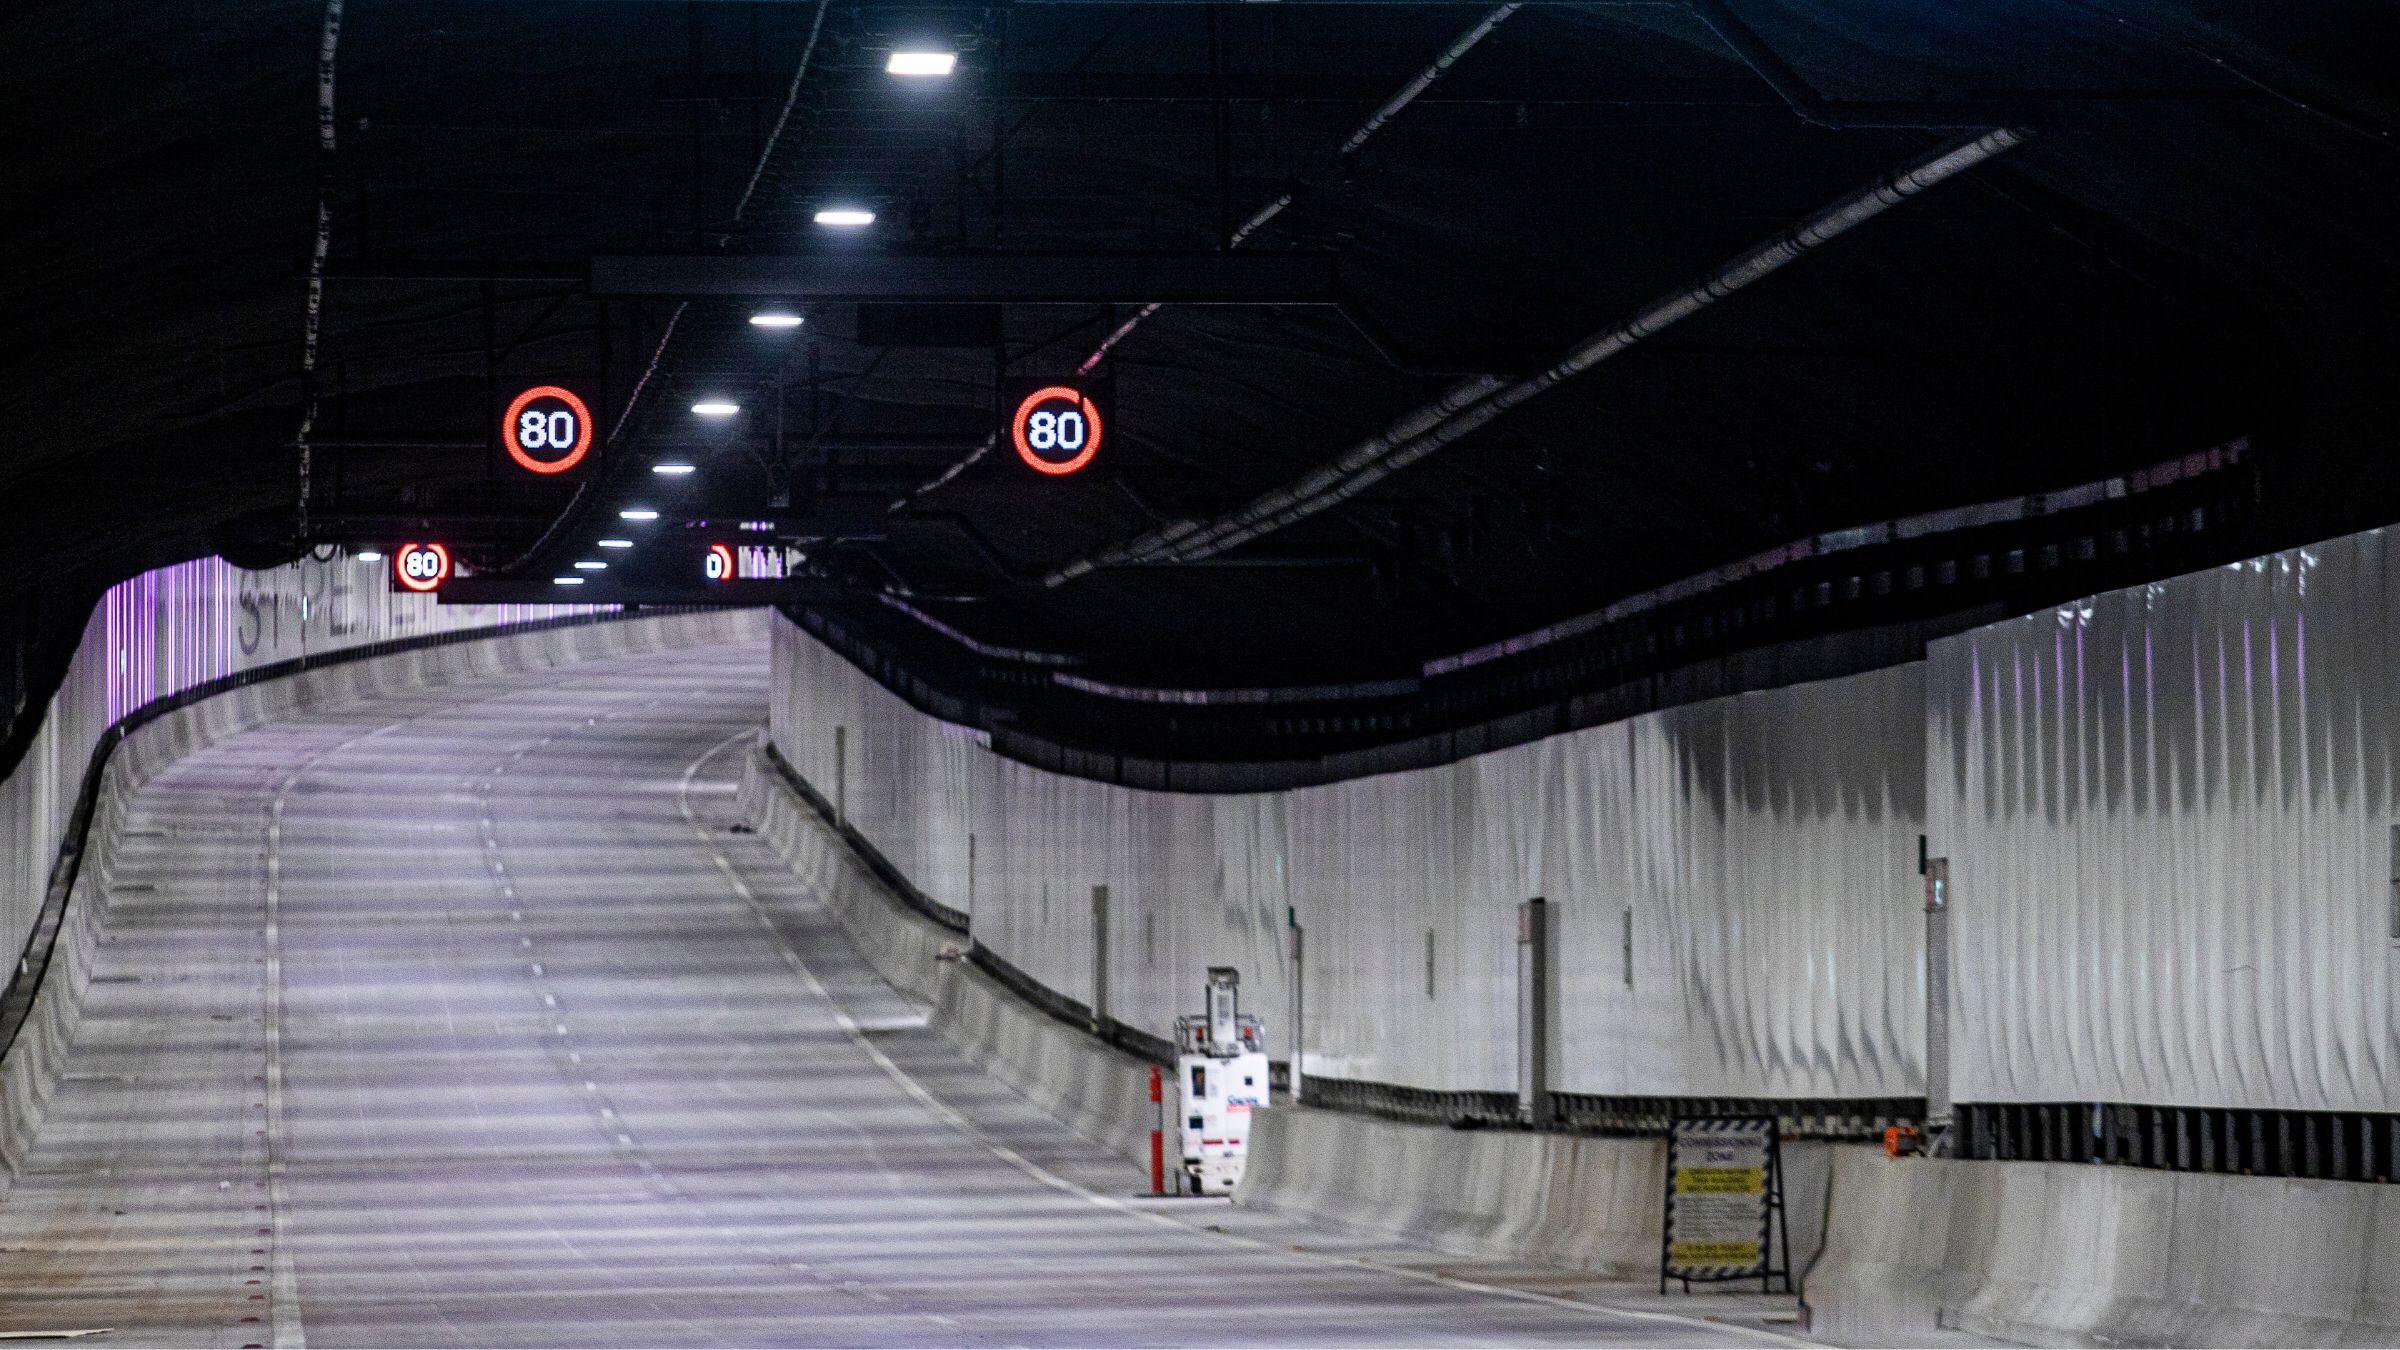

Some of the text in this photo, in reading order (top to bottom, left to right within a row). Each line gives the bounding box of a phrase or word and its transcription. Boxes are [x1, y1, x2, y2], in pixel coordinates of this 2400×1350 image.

[519, 410, 575, 450] 80
[1029, 410, 1085, 450] 80
[406, 551, 440, 577] 80
[706, 552, 723, 579] 0
